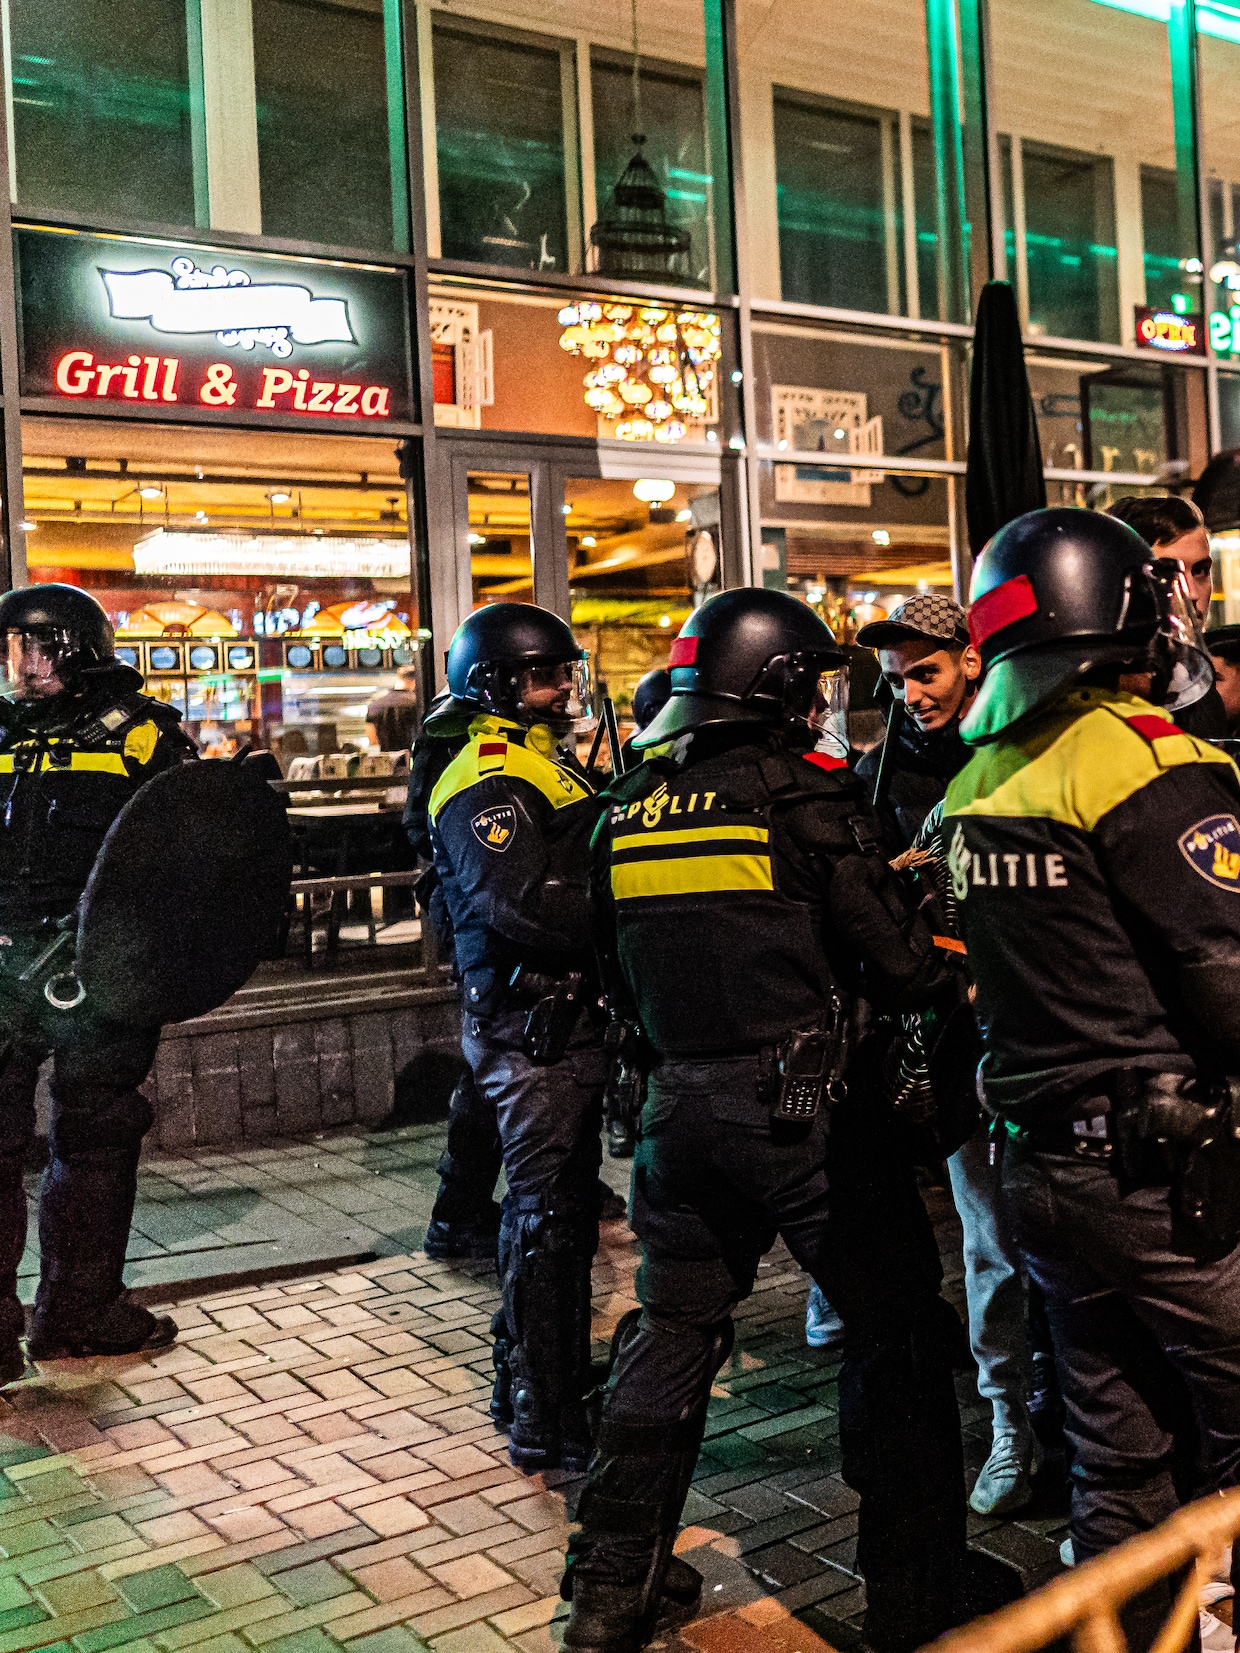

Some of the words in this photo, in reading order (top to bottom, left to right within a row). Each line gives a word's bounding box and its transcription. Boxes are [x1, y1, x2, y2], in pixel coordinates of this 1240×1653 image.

[1139, 318, 1197, 347] OPEN
[56, 350, 179, 402] Grill
[200, 362, 238, 406] &
[256, 367, 390, 417] Pizza
[474, 810, 512, 828] POLITIE
[626, 781, 717, 829] POLIT
[946, 832, 1069, 900] OLITIE
